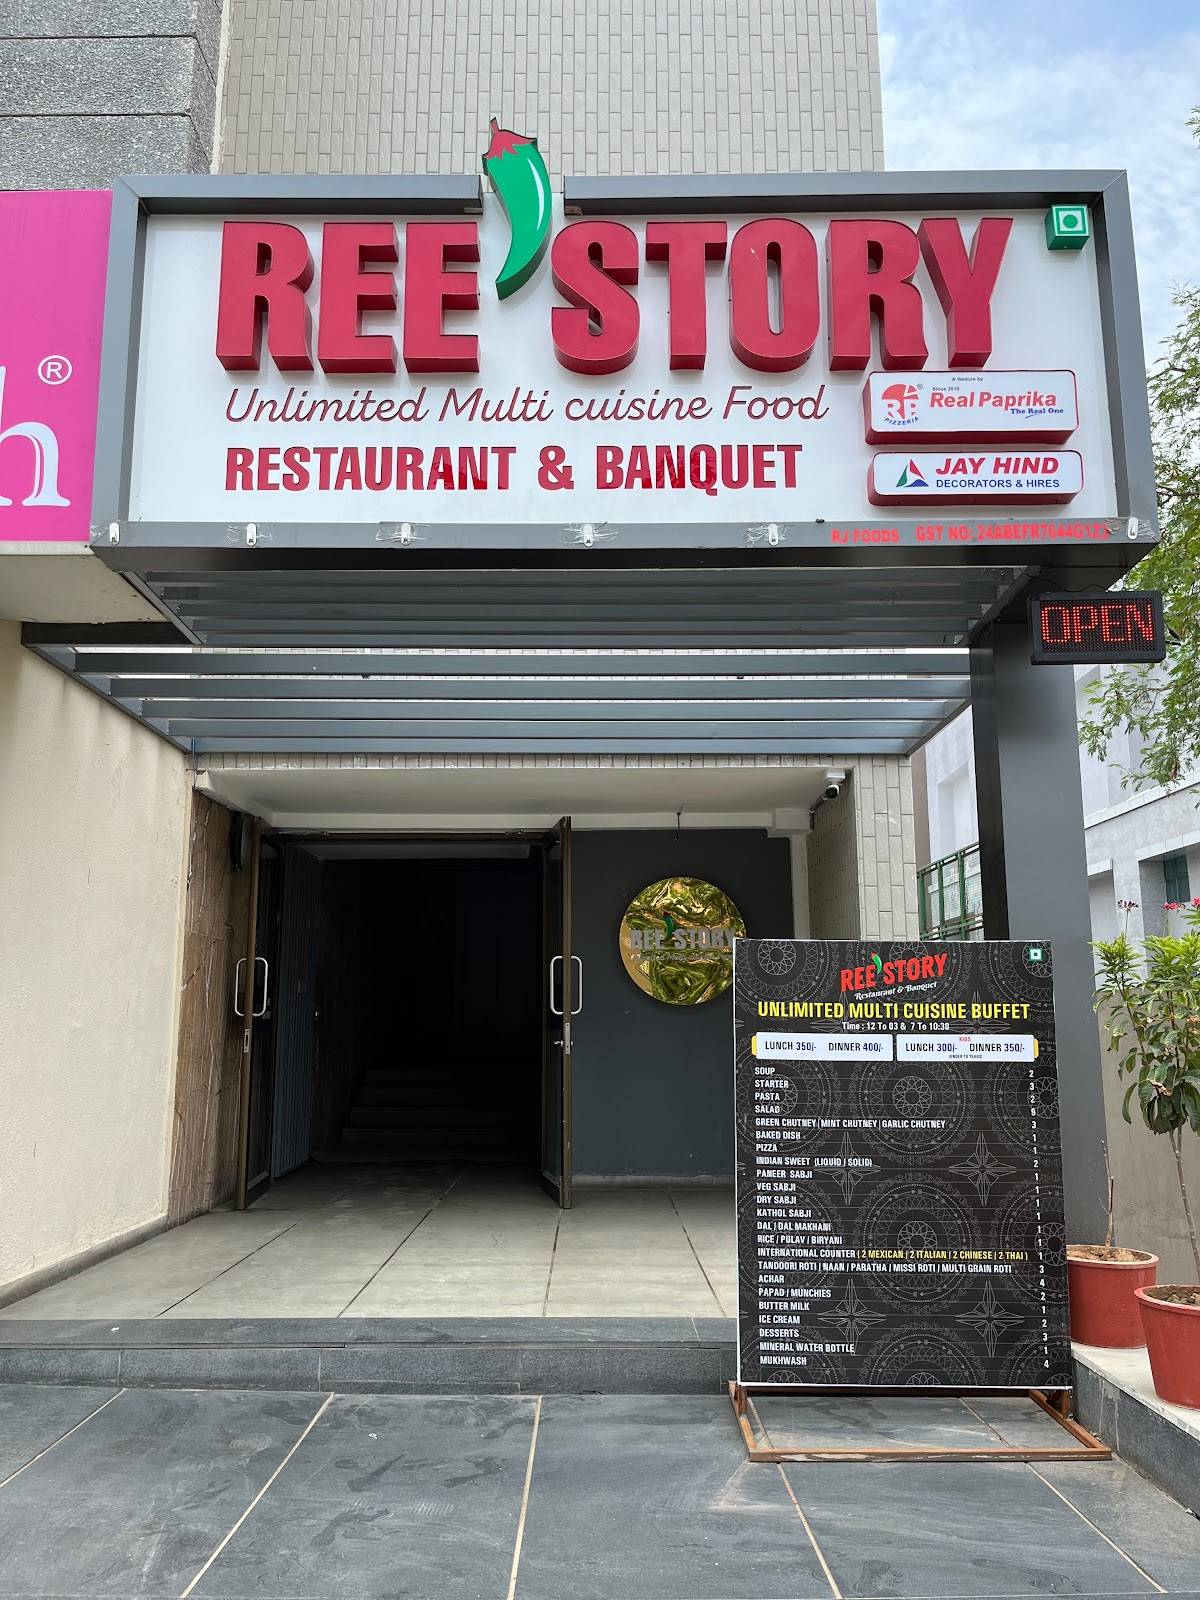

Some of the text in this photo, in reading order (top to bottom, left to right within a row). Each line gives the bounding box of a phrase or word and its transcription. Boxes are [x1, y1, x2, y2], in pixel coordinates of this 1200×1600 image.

[225, 385, 830, 423] Unlimited Multi cuisine Food
[930, 391, 1057, 410] Real Paprika
[884, 417, 920, 426] PIZZERIA
[225, 444, 802, 496] RESTAURANT & BANQUET
[936, 457, 1059, 475] JAY HIND
[937, 479, 1060, 488] DECORATORS & HIRES
[832, 529, 849, 544] RJ
[853, 529, 900, 543] FOODS
[916, 525, 944, 542] GST
[1041, 604, 1153, 642] OPEN
[854, 988, 896, 1000] Restaurant
[905, 982, 937, 992] Banquet
[758, 1001, 1030, 1020] UNLIMITED MULTI CUISINE BUFFET
[842, 1022, 860, 1030] Time
[867, 1022, 876, 1030] 12
[911, 1023, 916, 1031] 7
[917, 1023, 927, 1031] To
[929, 1023, 950, 1031] 10:30
[765, 1041, 884, 1052] LUNCH 350/- DINNER 400/-
[906, 1042, 1025, 1053] LUNCH 300/- DINNER 350/-
[755, 1067, 1034, 1078] SOUP 2
[755, 1080, 1035, 1091] STARTER 3
[755, 1093, 1036, 1104] PASTA 2
[755, 1106, 780, 1114] SALAD
[756, 1118, 1037, 1129] GREEN CHUTNEY MINT CHUTNEY GARLIC CHUTNEY 3
[756, 1131, 1037, 1142] BAKED DISH 1
[756, 1144, 1037, 1155] PIZZA 1
[756, 1157, 783, 1165] INDIAN
[785, 1157, 810, 1166] SWEET
[1033, 1159, 1039, 1168] 2
[757, 1170, 1039, 1181] PANEER SABJI 1
[757, 1183, 1040, 1194] VEG SABJI 1
[757, 1196, 1040, 1208] DRY SABJI 1
[757, 1209, 1041, 1221] KATHOL SABJI 1
[757, 1222, 1042, 1234] DAL DAL MAKHANI 1
[758, 1235, 1042, 1247] RICE PULAV BIRYANI 1
[758, 1248, 818, 1257] INTERNATIONAL
[820, 1249, 855, 1258] COUNTER
[868, 1250, 903, 1259] MEXICAN
[916, 1251, 947, 1259] ITALIAN
[960, 1251, 992, 1259] CHINESE
[1005, 1252, 1023, 1260] THAI
[1038, 1251, 1043, 1261] 1
[758, 1261, 1045, 1274] TANDOORI ROTI NAAN PARATHA MISSI ROTI MULTI GRAIN ROTI 3
[758, 1275, 1046, 1287] ACHAR 4
[759, 1288, 1046, 1301] PAPAD MUNCHIES 2
[759, 1302, 1046, 1314] BUTTER MILK 1
[759, 1315, 1048, 1328] ICE CREAM 2
[759, 1329, 1048, 1342] DESSERTS 3
[760, 1342, 1048, 1355] MINERAL WATER BOTTLE 1
[760, 1356, 1050, 1369] MUKHWASH 4
